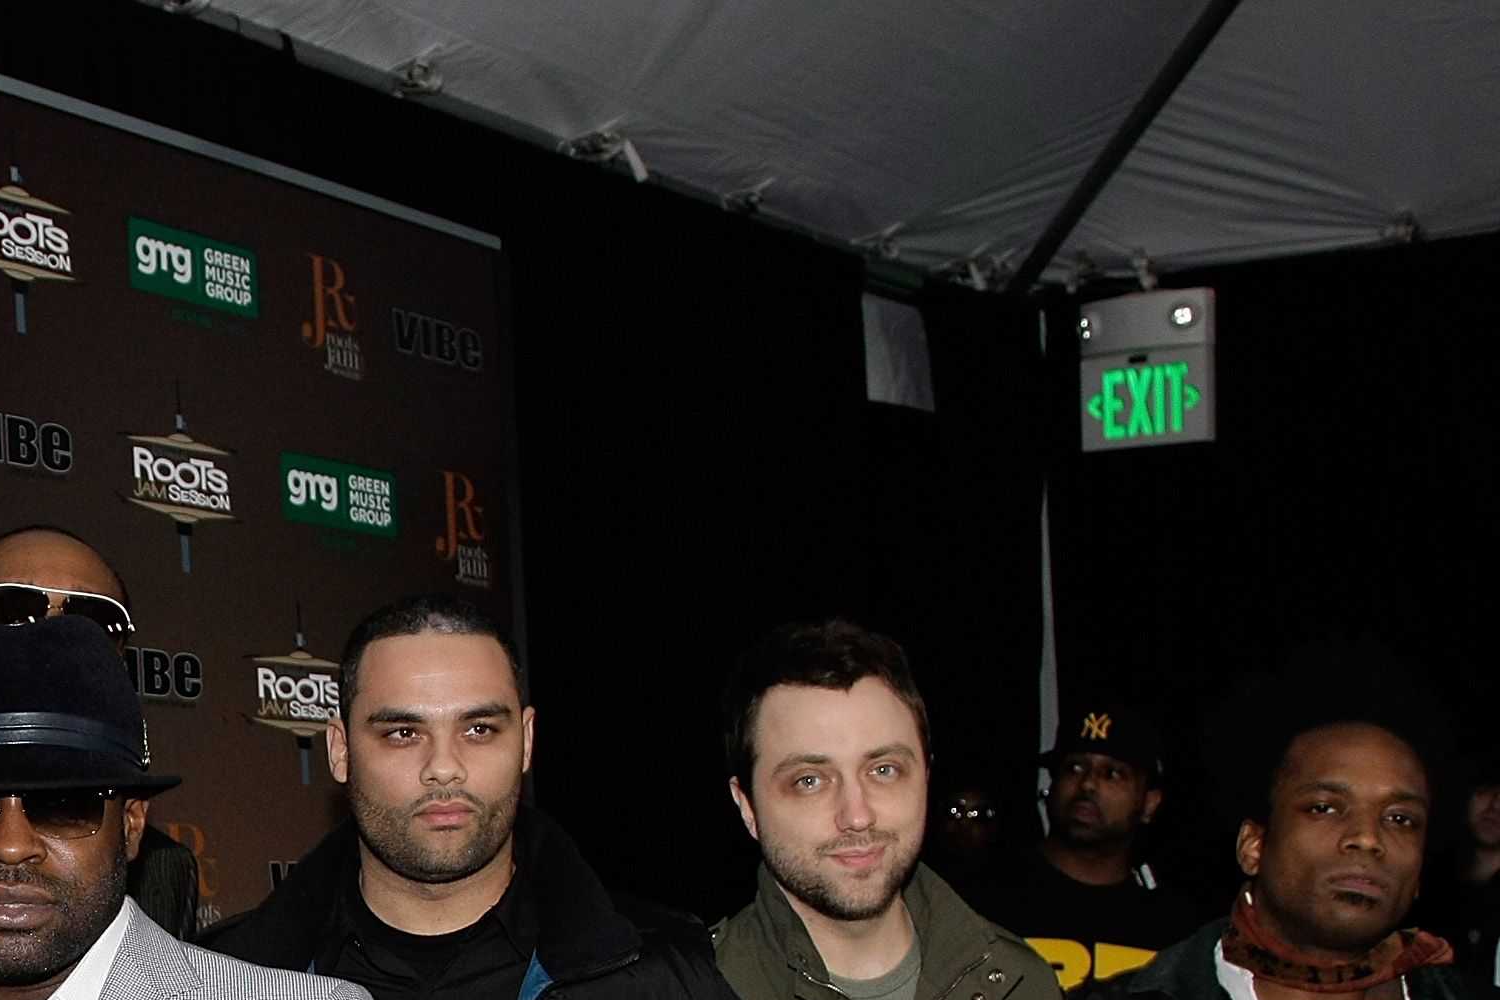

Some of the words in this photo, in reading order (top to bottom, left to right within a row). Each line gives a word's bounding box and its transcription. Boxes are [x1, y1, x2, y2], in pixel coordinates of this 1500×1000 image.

[1, 238, 72, 272] SESSION
[135, 236, 192, 284] gmg
[203, 247, 251, 275] GREEN
[205, 264, 251, 290] MUSIC
[205, 281, 252, 306] GROUP
[1103, 361, 1189, 440] EXIT
[132, 446, 229, 494] ROOTS
[133, 477, 167, 500] JAM
[168, 484, 231, 512] SESSION
[287, 468, 338, 512] gmg
[348, 474, 390, 496] GREEN
[349, 490, 391, 512] MUSIC
[349, 506, 392, 528] GROUP
[257, 667, 340, 705] ROOTS
[257, 697, 289, 716] JAM
[1080, 712, 1112, 740] NY
